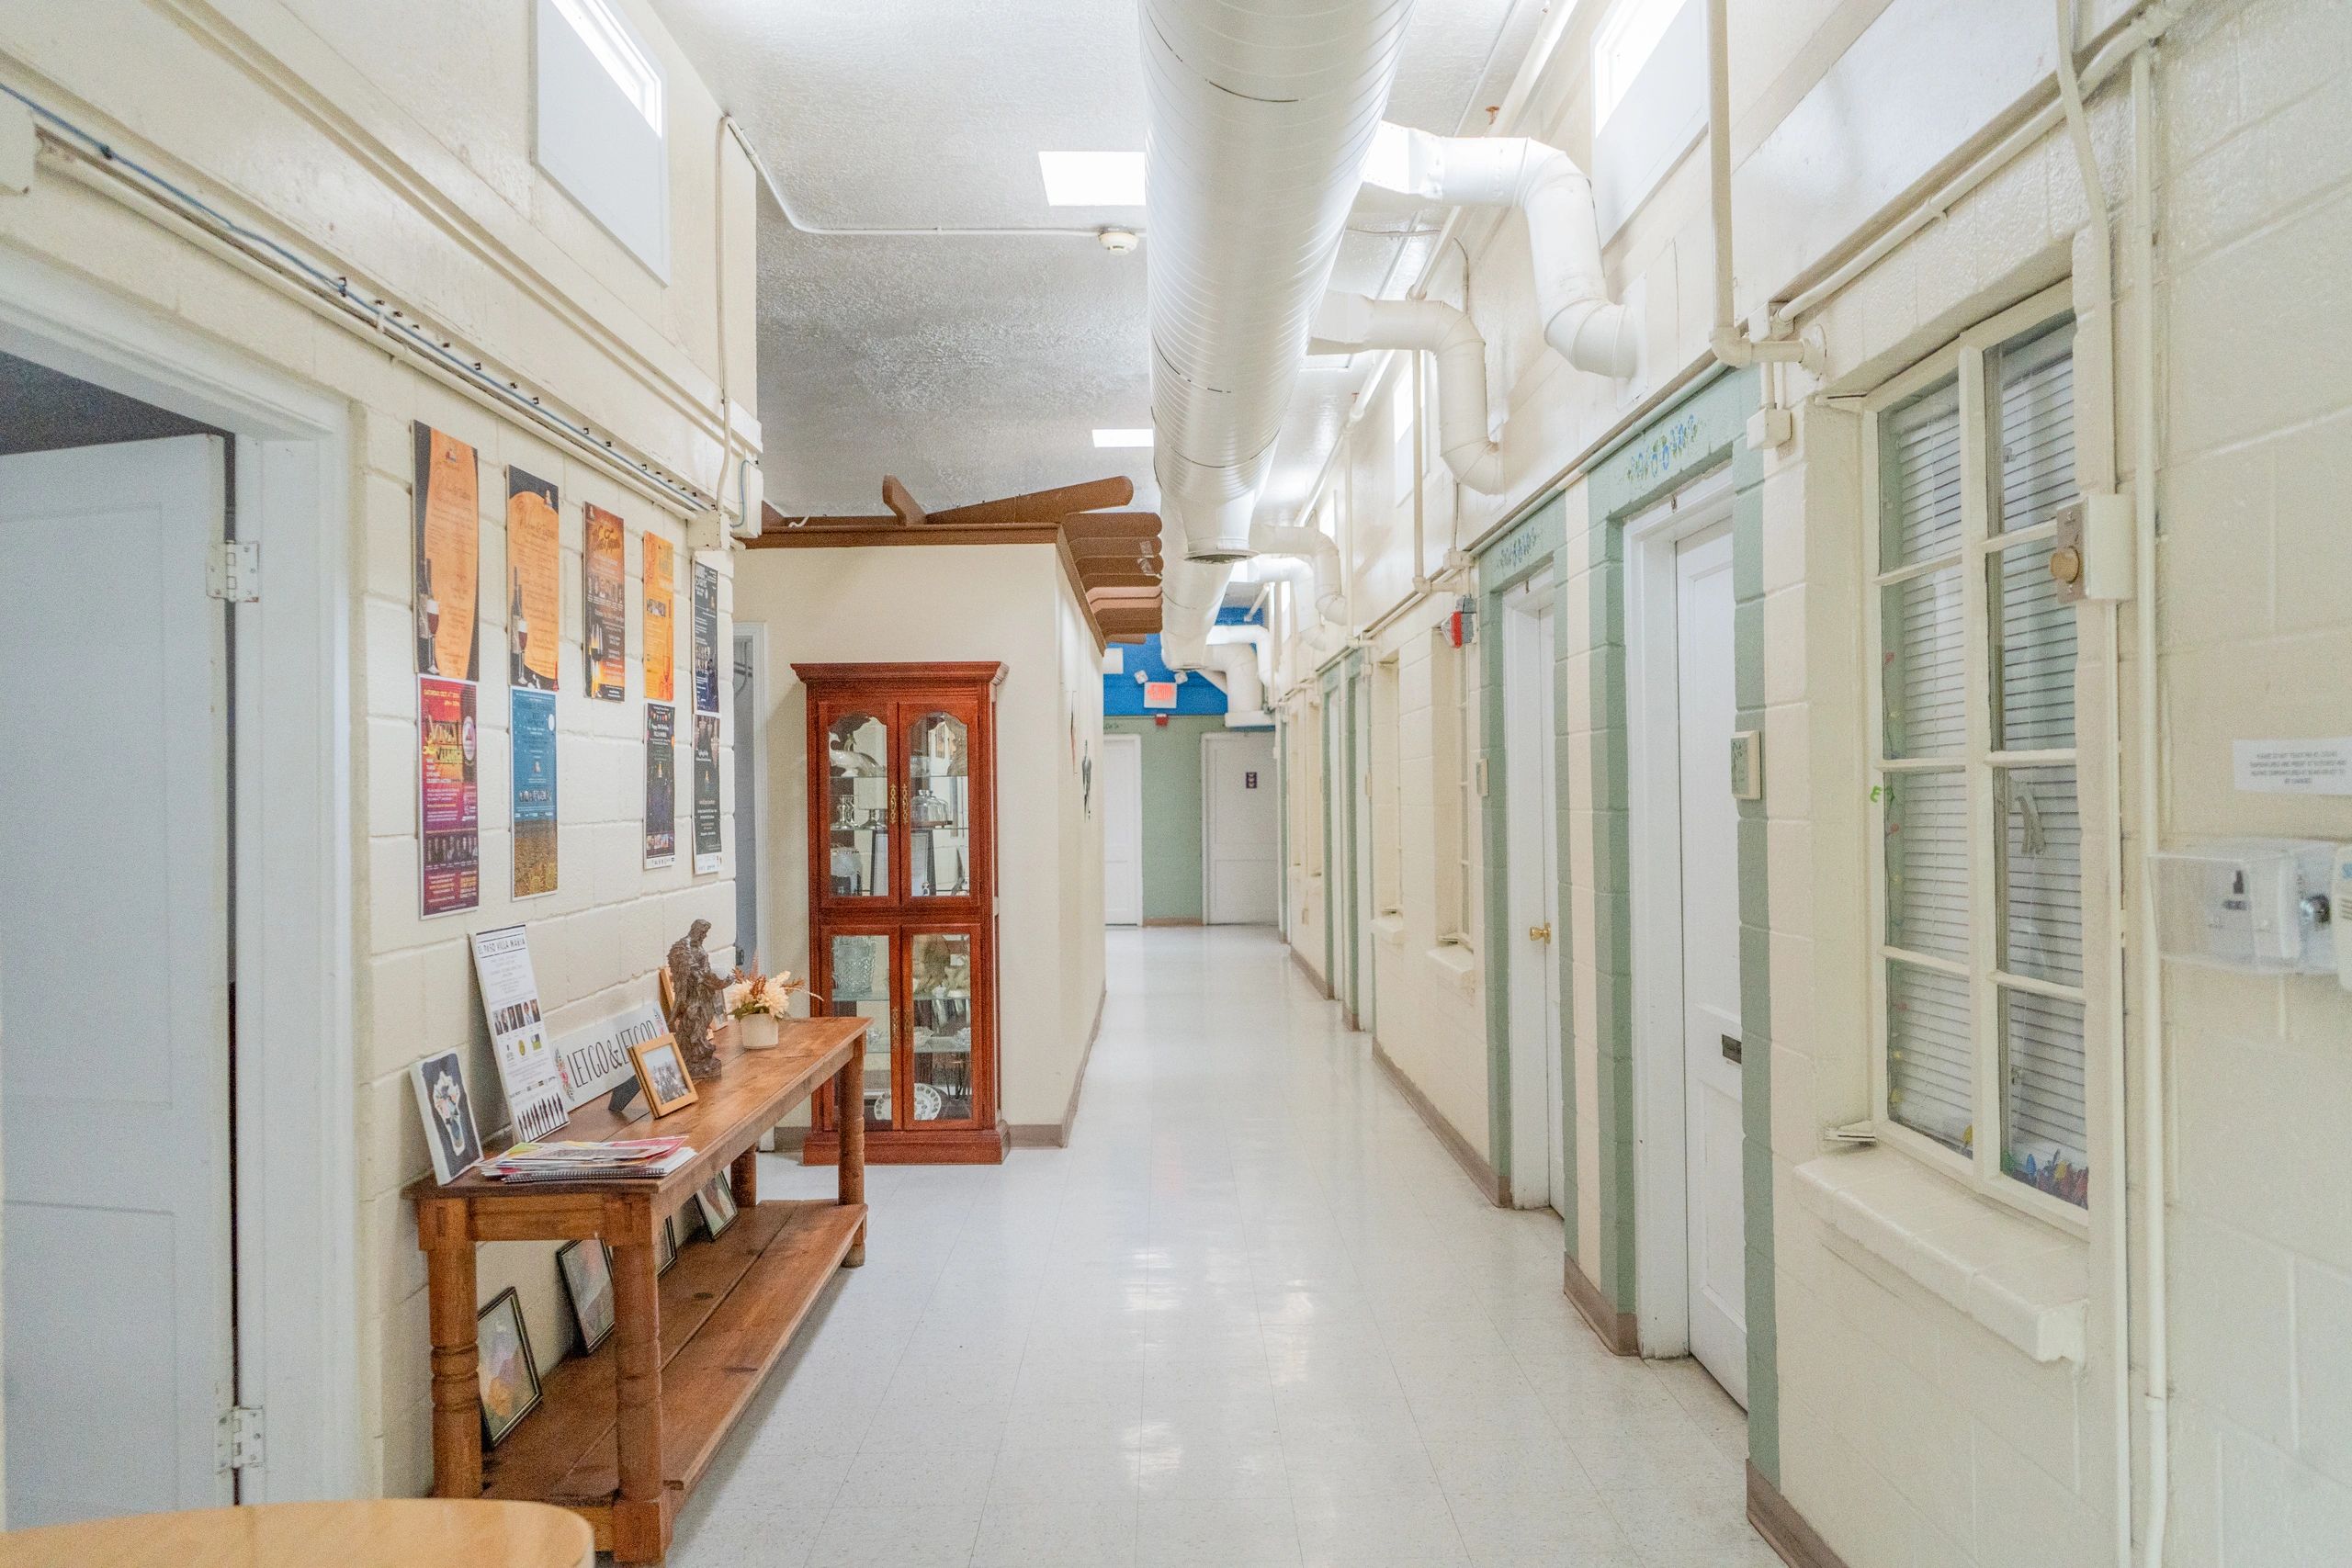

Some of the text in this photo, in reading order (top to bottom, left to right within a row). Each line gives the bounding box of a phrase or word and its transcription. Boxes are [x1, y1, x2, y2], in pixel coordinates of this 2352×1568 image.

[567, 1048, 593, 1088] LET
[588, 1042, 610, 1077] GO
[606, 1040, 622, 1069] &
